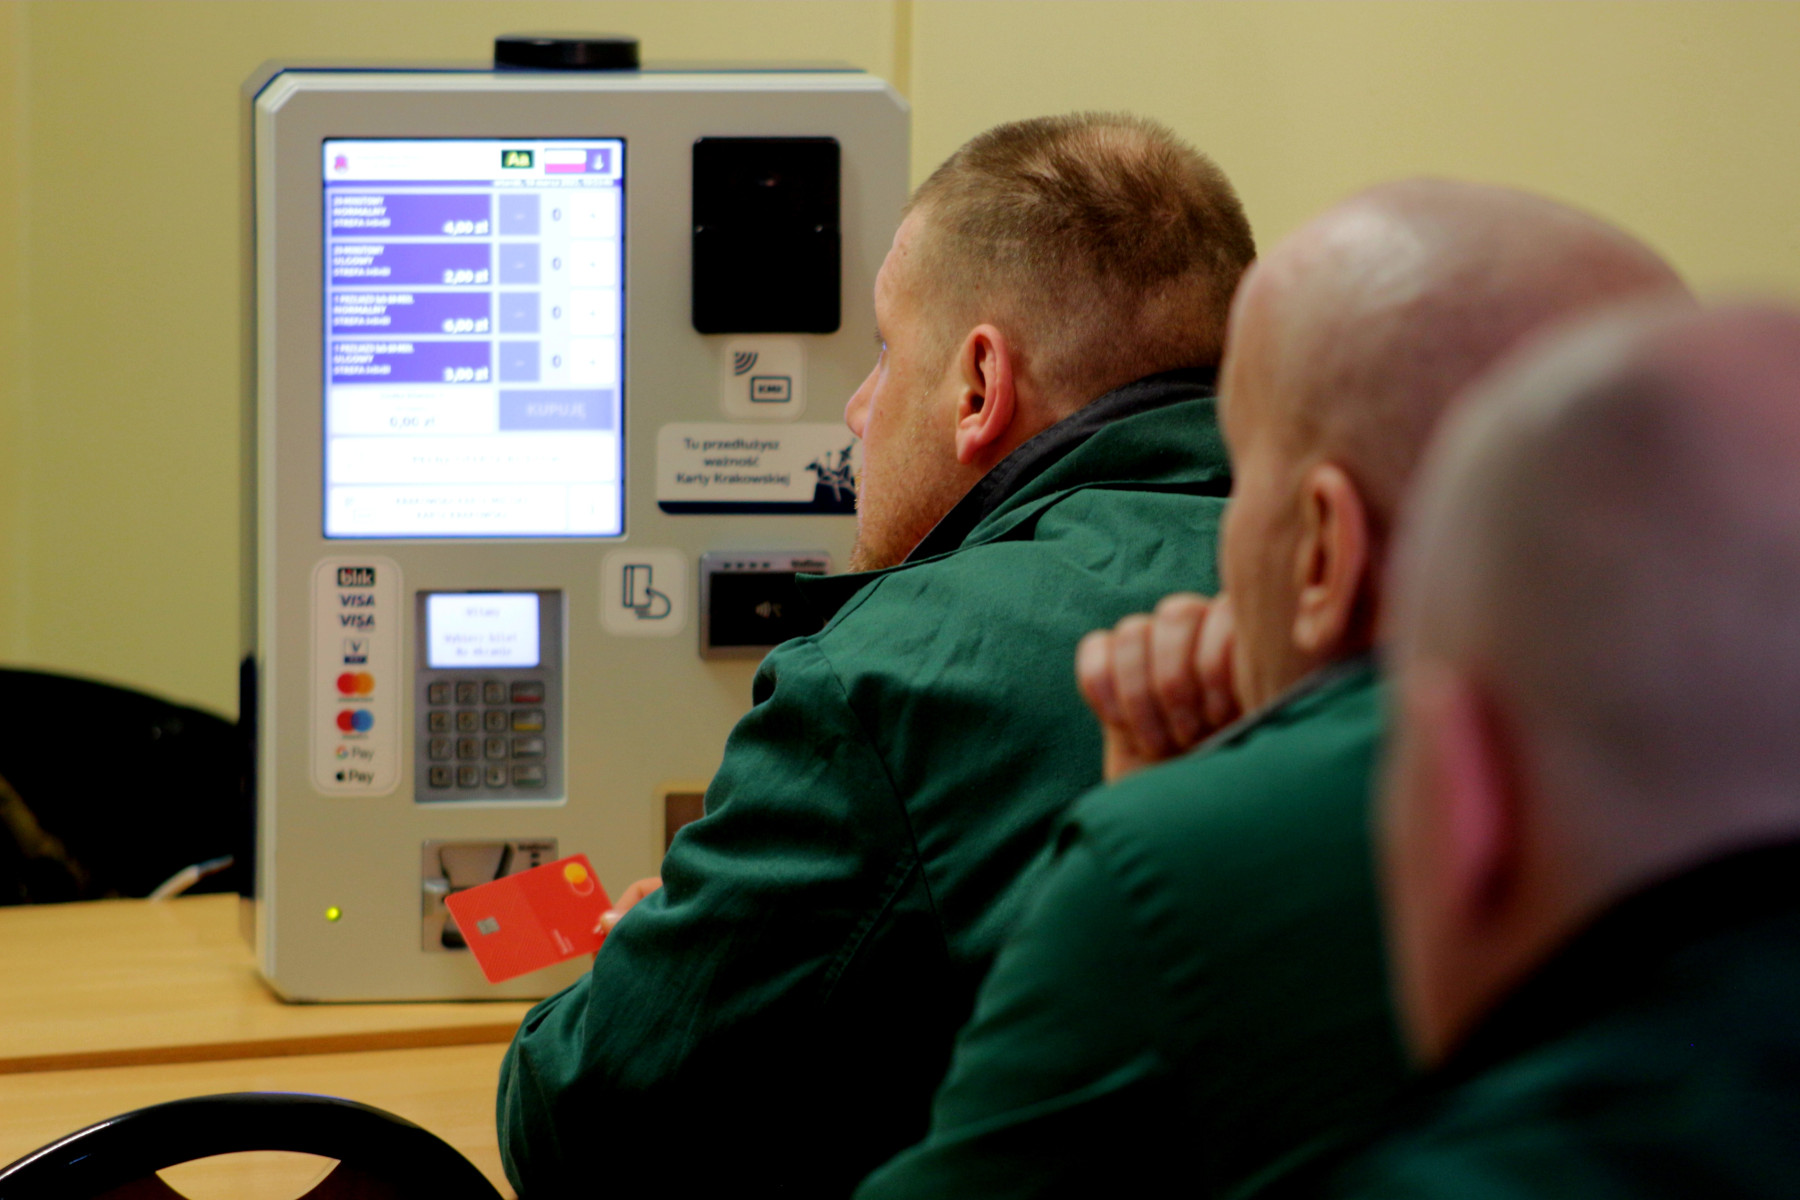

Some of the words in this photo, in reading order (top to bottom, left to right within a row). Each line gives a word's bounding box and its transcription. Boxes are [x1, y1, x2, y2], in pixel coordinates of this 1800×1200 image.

[505, 152, 530, 167] Aa
[443, 221, 473, 235] 4,00
[475, 220, 489, 233] zł
[443, 270, 473, 284] 2,00
[475, 269, 489, 282] zł
[475, 318, 489, 332] zł
[475, 367, 489, 381] zł
[684, 438, 699, 450] Tu
[703, 437, 780, 455] przedłużysz
[703, 454, 759, 468] ważność
[676, 472, 710, 486] Karty
[714, 472, 791, 487] Krakowskiej
[340, 569, 373, 586] blik
[341, 594, 375, 607] VISA
[341, 614, 375, 627] VISA
[352, 747, 375, 763] Pay
[349, 769, 375, 785] Pay
